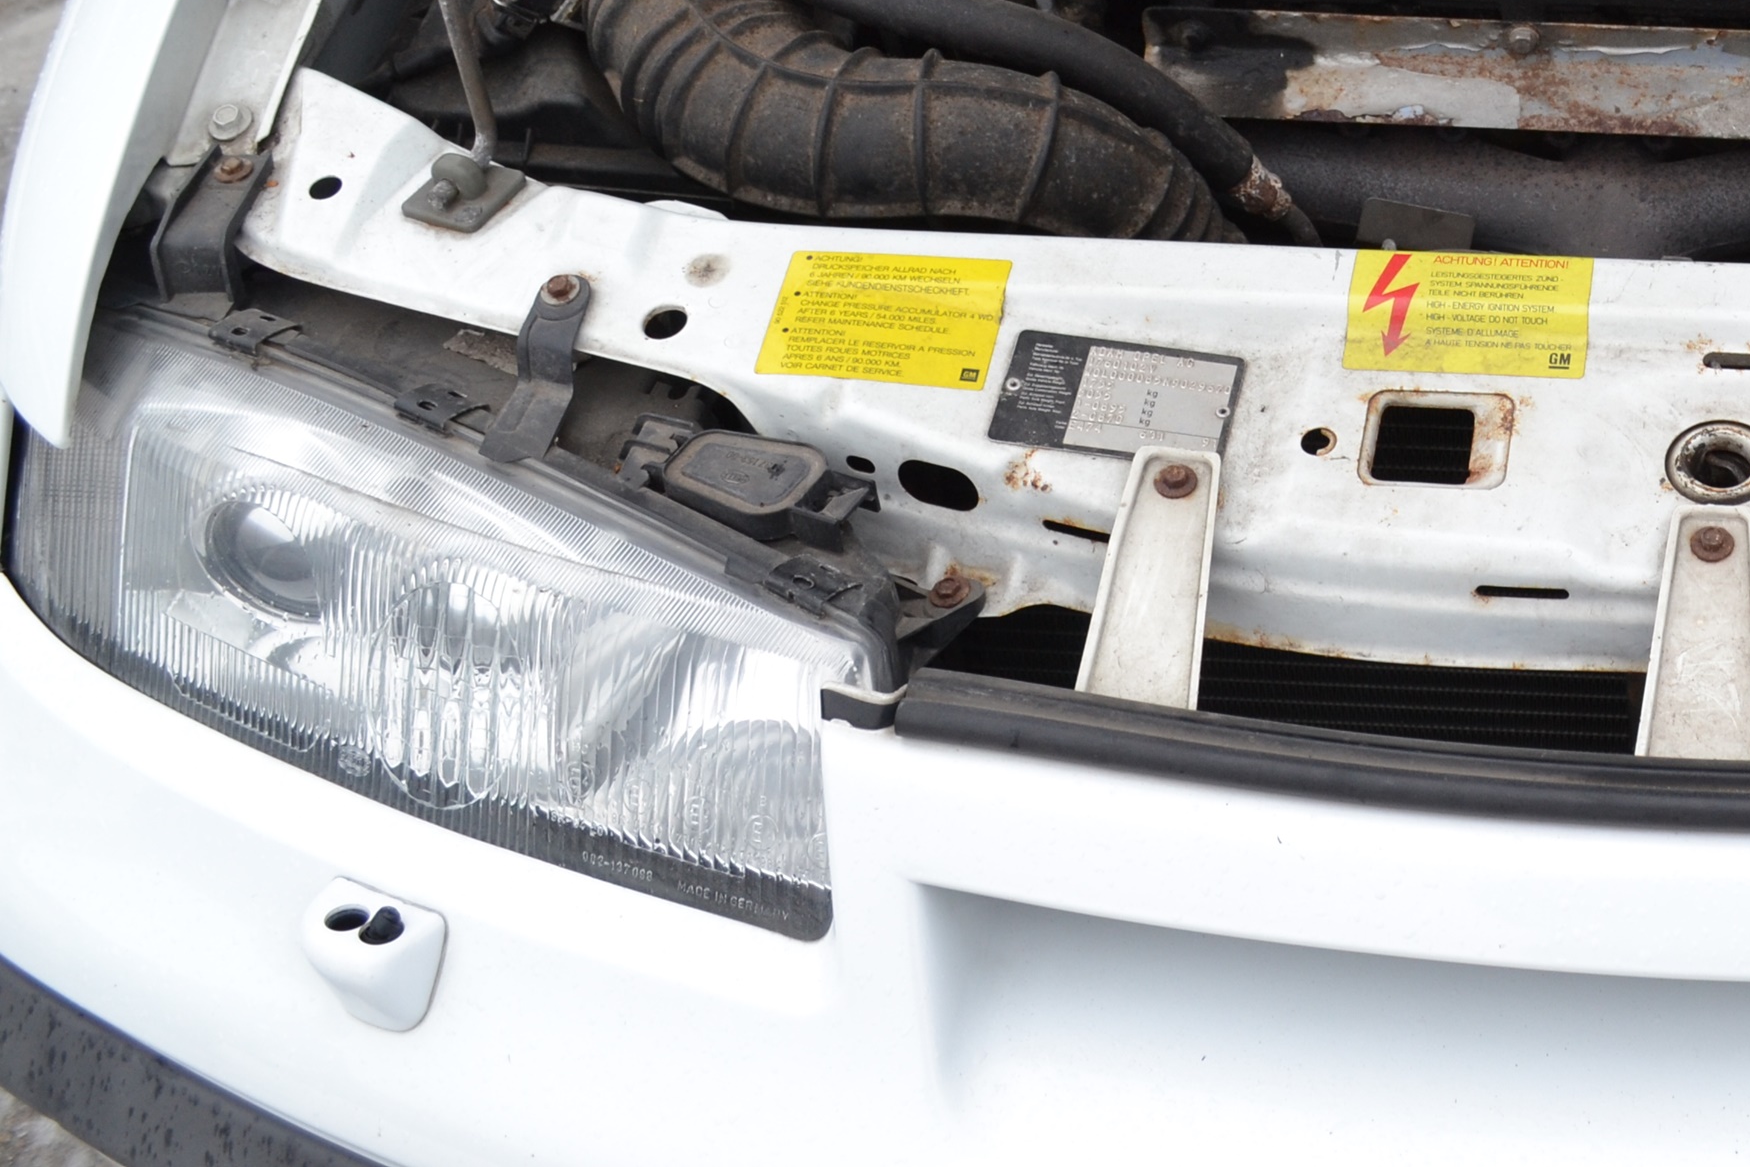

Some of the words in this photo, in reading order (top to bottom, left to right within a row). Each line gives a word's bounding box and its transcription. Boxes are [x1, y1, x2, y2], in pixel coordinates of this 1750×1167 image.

[815, 255, 863, 263] ACHTUNG!
[1433, 255, 1497, 267] ACHTUNG!
[1500, 257, 1569, 269] ATTENTION!
[812, 263, 890, 272] DRUCKSPEICHER
[892, 266, 927, 274] ALLRAD
[1430, 279, 1462, 287] SYSTEM
[803, 291, 858, 300] ATTENTION!
[800, 299, 841, 308] CHANGE
[843, 301, 893, 312] PRESSURE
[895, 306, 967, 318] ACCUMULATOR
[1426, 300, 1446, 308] HIGH
[1452, 301, 1485, 311] ENERGY
[1488, 302, 1520, 312] IGNITION
[797, 307, 827, 315] AFTER
[839, 309, 869, 318] YEARS
[795, 316, 825, 324] REFER
[828, 318, 895, 330] MAINTENANCE
[1426, 313, 1445, 321] HIGH
[1452, 314, 1486, 323] VOLTAGE
[1488, 315, 1501, 324] DO
[1502, 316, 1518, 324] NOT
[1522, 316, 1548, 325] TOUCH
[791, 327, 846, 336] ATTENTION!
[1425, 326, 1463, 336] SYSTEME
[788, 336, 846, 345] REMPLACER
[862, 340, 915, 351] RESERVOIR
[928, 346, 976, 357] PRESSION
[1433, 339, 1461, 347] HAUTE
[1465, 340, 1499, 348] TENSION
[1501, 341, 1513, 349] NE
[1514, 342, 1531, 350] PAS
[1534, 342, 1572, 351] TOUCHER
[786, 344, 823, 353] TOUTES
[825, 346, 859, 355] ROUES
[861, 349, 911, 360] MOTRICES
[782, 353, 813, 361] APRES
[824, 355, 844, 363] ANS
[1133, 350, 1166, 364] OPEL
[1176, 356, 1195, 368] AG
[1548, 352, 1572, 366] GM
[805, 362, 843, 371] CARNET
[962, 370, 978, 379] GM
[1147, 388, 1158, 399] kg
[1144, 398, 1156, 408] kg
[1141, 407, 1153, 418] kg
[1139, 417, 1151, 427] kg
[676, 880, 711, 900] MADE
[714, 890, 728, 905] IN
